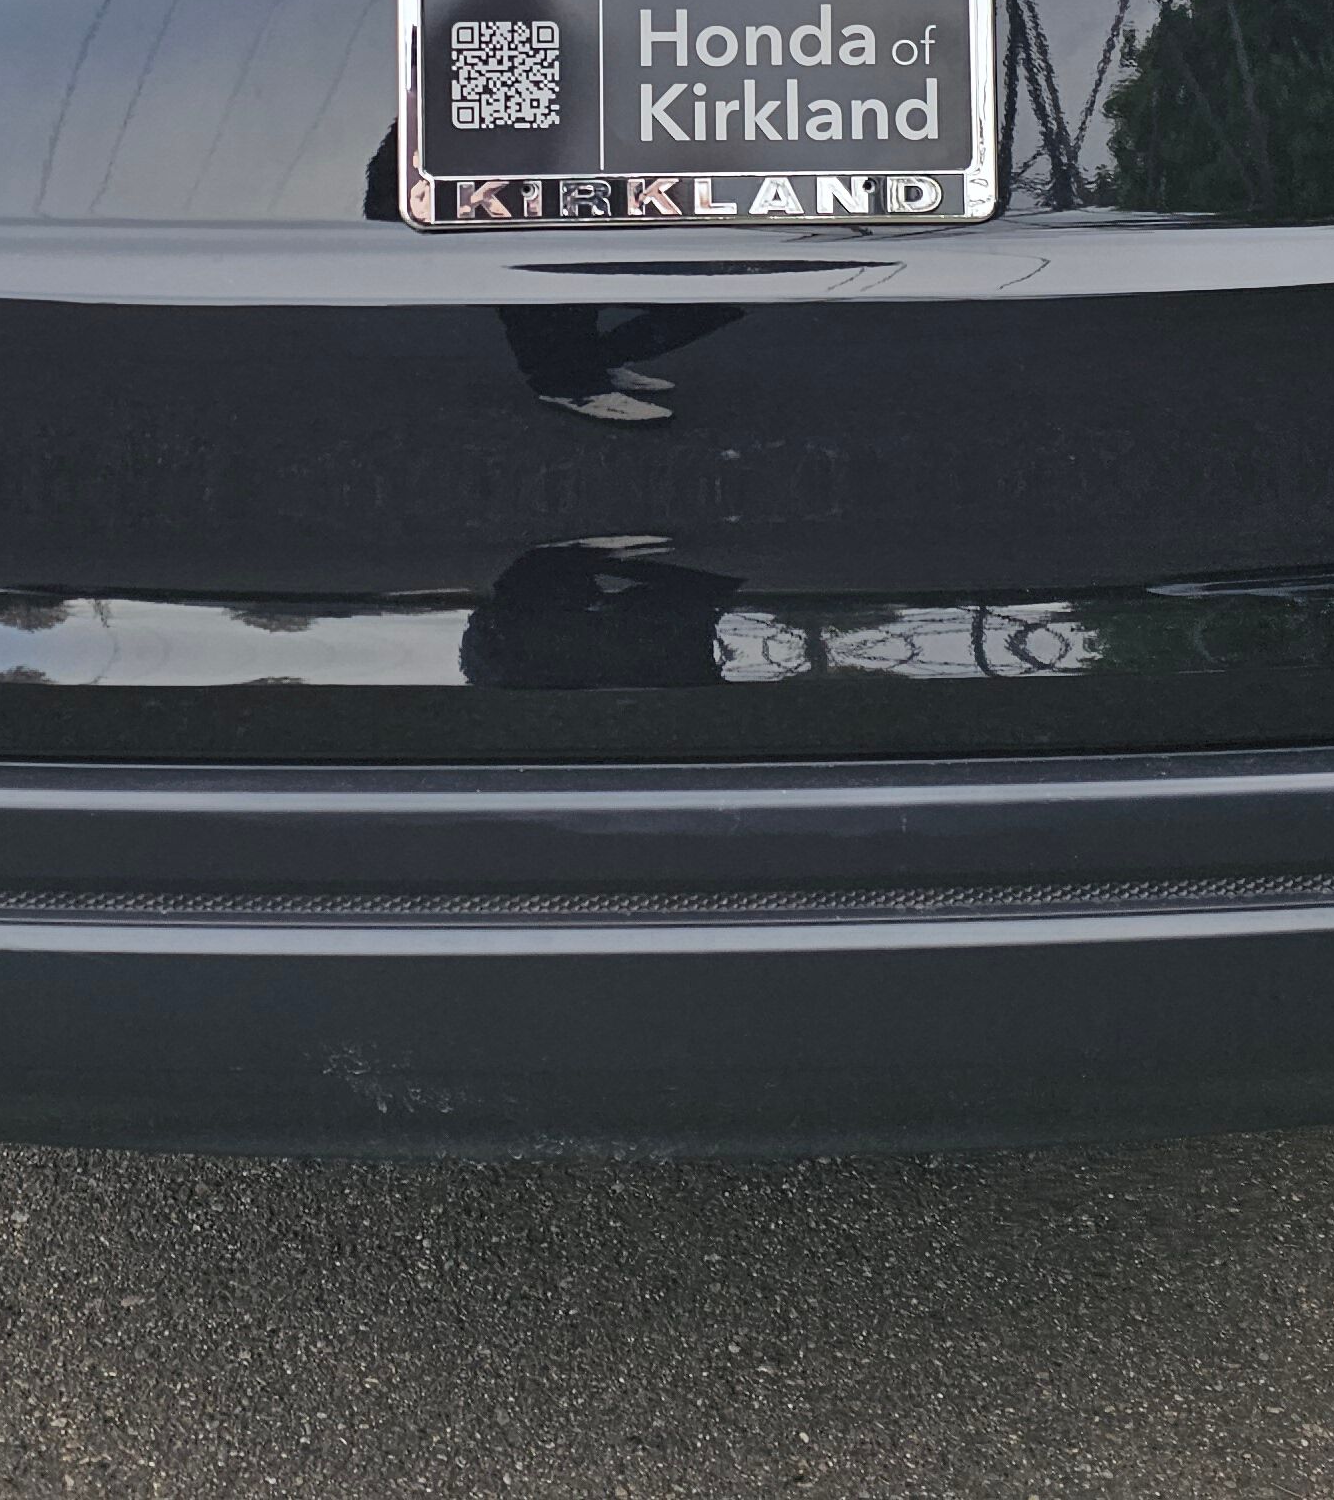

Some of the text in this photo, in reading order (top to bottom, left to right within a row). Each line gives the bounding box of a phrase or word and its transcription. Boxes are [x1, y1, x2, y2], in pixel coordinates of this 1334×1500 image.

[639, 3, 936, 67] Honda of
[639, 78, 940, 143] Kirkland
[456, 176, 943, 219] KIRKLAND
